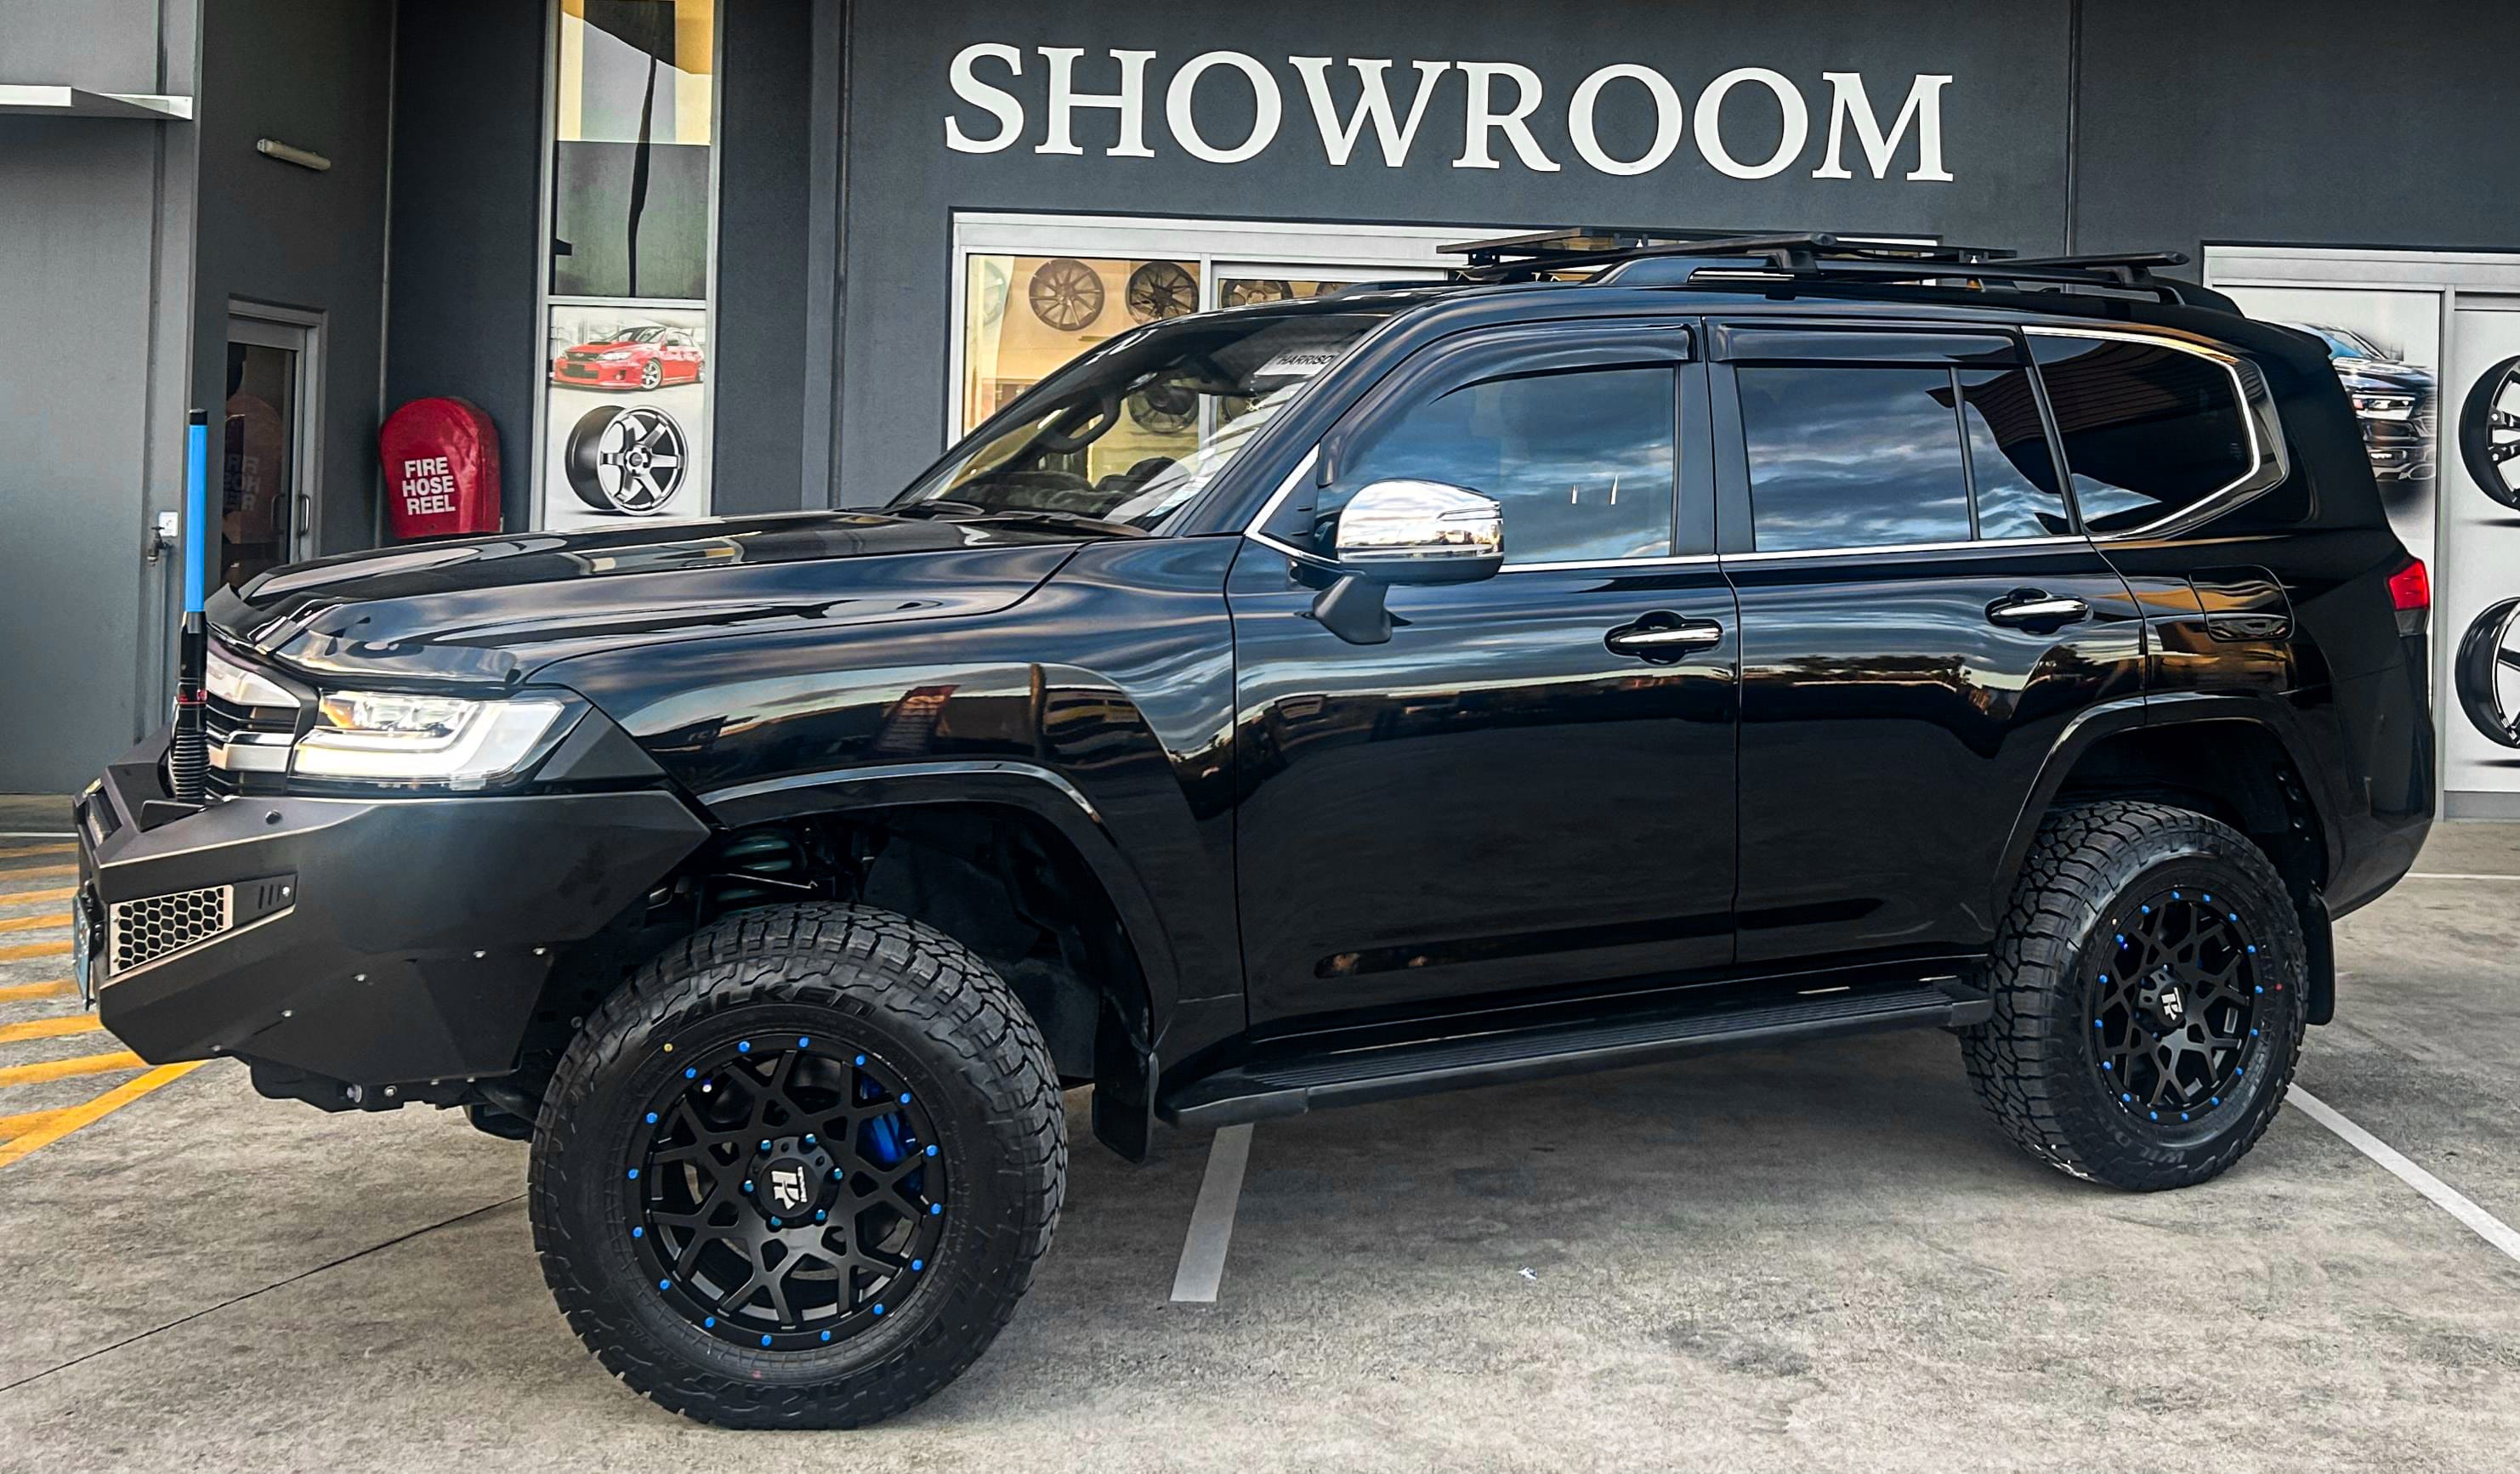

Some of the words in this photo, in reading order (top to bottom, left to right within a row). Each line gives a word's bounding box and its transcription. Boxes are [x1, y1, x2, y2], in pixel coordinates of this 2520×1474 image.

[945, 43, 1954, 182] SHOWROOM
[405, 456, 449, 478] FIRE
[402, 475, 455, 497] HOSE
[406, 495, 456, 515] REEL
